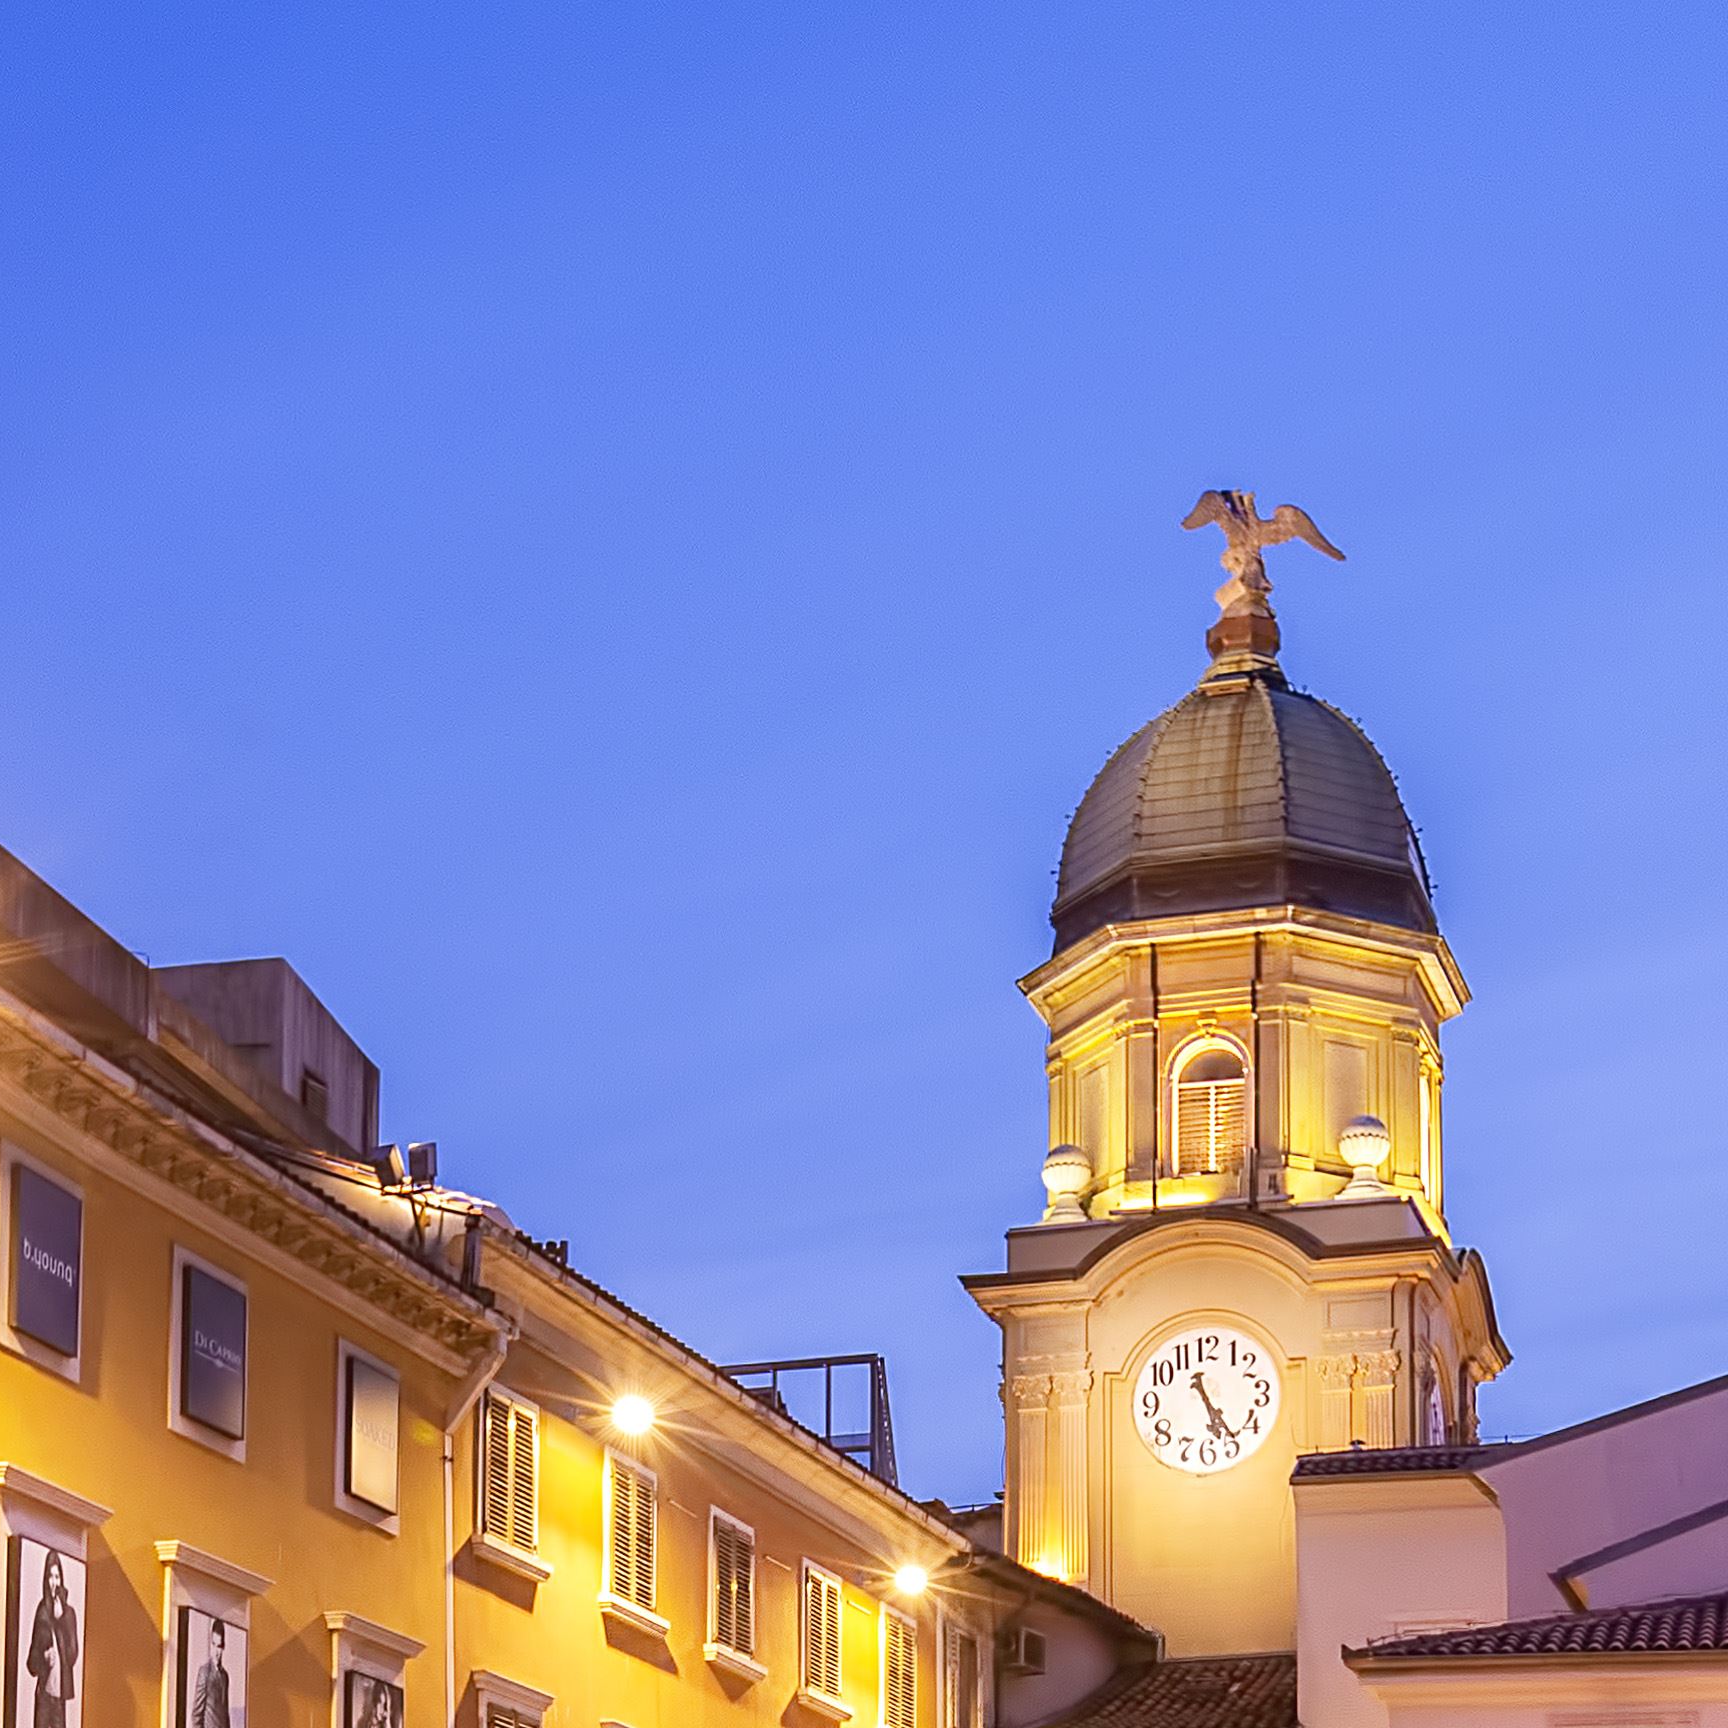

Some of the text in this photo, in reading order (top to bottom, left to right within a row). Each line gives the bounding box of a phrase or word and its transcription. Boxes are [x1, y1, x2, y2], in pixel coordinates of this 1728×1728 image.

[1173, 1343, 1190, 1370] 11
[1195, 1335, 1219, 1363] 12
[1228, 1340, 1237, 1367] 1
[1151, 1360, 1174, 1387] 10
[1242, 1352, 1258, 1379] 2
[1142, 1390, 1160, 1419] 9
[1254, 1379, 1270, 1408] 3
[1154, 1418, 1172, 1447] 8
[1241, 1409, 1261, 1435] 4
[1178, 1436, 1195, 1462] 7
[1199, 1438, 1217, 1466] 6
[1223, 1430, 1241, 1459] 5
